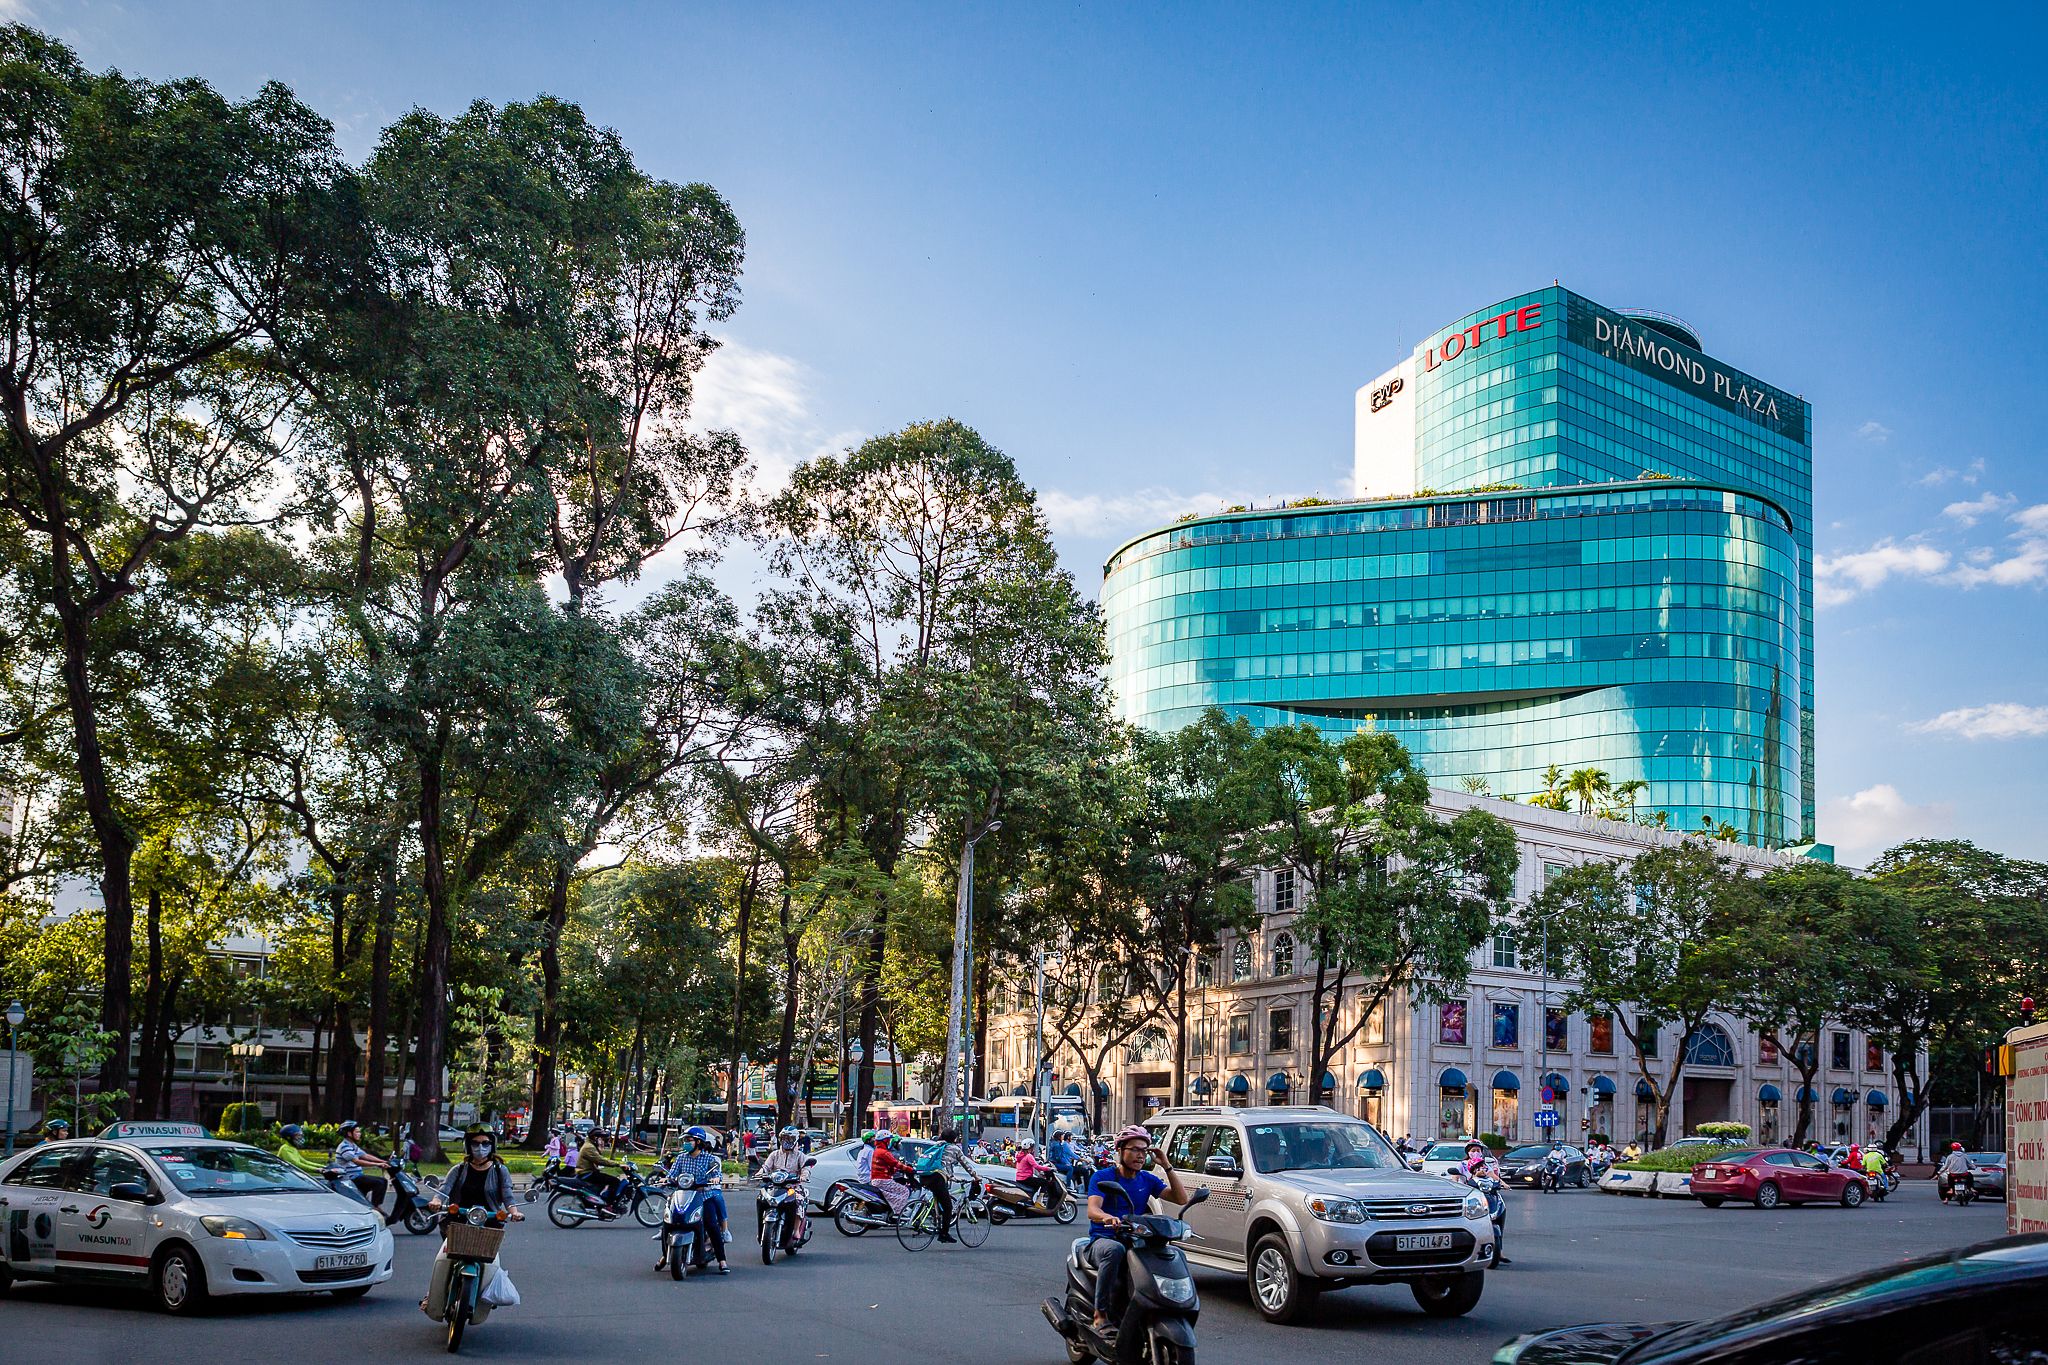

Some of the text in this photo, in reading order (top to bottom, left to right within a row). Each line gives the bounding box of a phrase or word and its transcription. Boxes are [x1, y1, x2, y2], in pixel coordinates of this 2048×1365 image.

[1424, 303, 1541, 372] LOTTE
[1595, 317, 1780, 420] DIAMOND PLAZA
[1371, 377, 1403, 407] FWD
[1580, 808, 1665, 846] diamond
[2018, 1138, 2045, 1161] CHÚ Ý:
